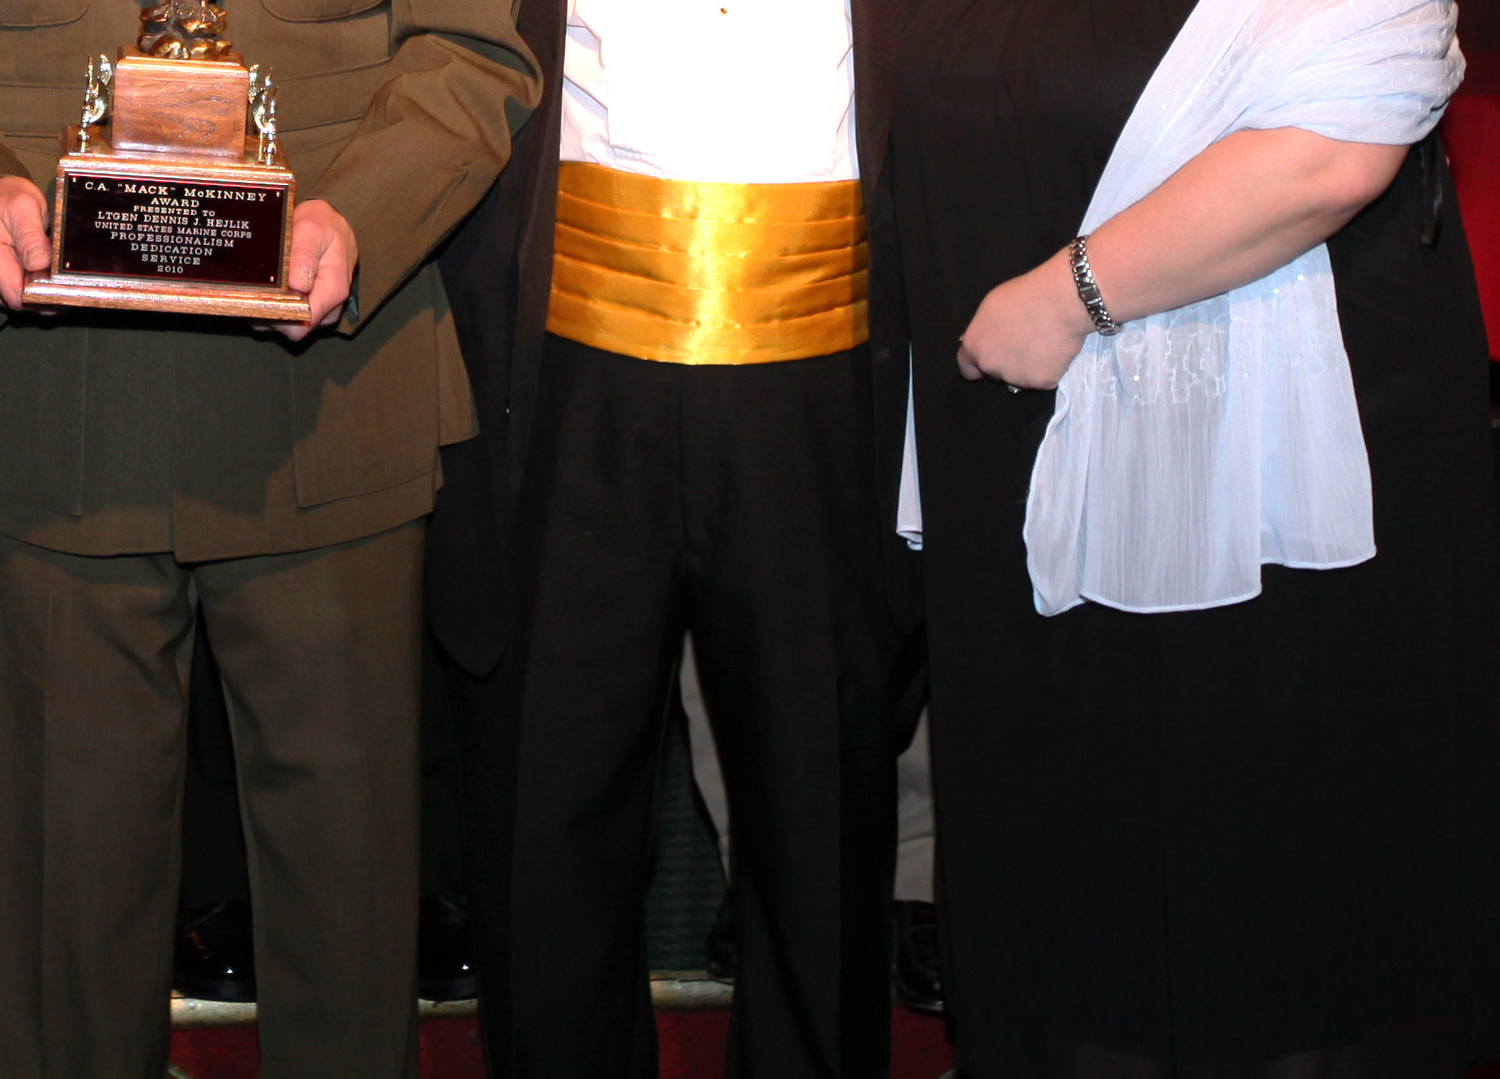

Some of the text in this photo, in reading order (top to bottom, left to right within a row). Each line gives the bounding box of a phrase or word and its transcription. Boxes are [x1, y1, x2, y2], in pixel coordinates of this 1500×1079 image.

[84, 181, 110, 192] C.A.
[117, 183, 176, 196] "MACK"
[150, 197, 200, 208] AWARD
[133, 205, 198, 216] PRESENTED
[97, 211, 250, 229] LTGEN DENNIS J. HEJLIK
[94, 221, 252, 239] UNITED STATES MARINE CORPS
[110, 231, 235, 247] PROFESSIONALISM
[130, 242, 213, 256] DEDICATION
[141, 254, 201, 266] SERVICE
[157, 265, 184, 274] 2010
